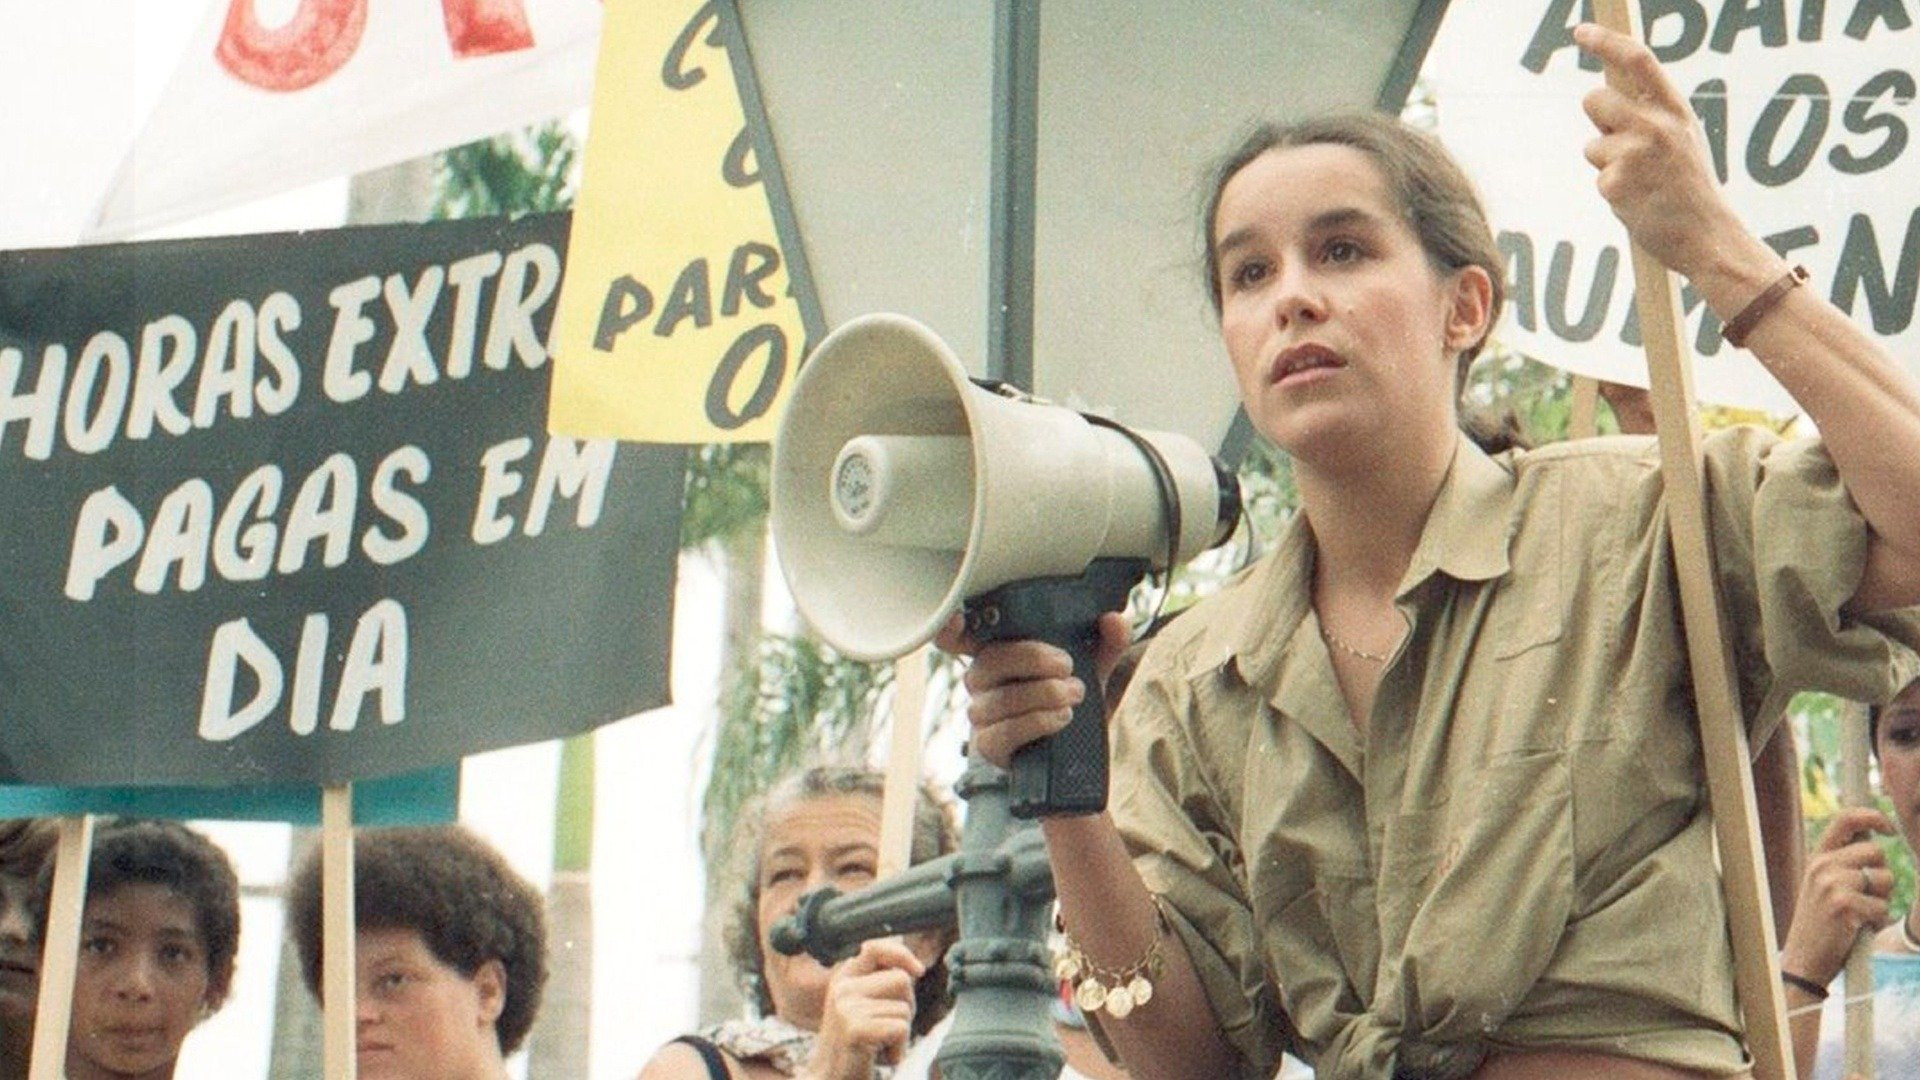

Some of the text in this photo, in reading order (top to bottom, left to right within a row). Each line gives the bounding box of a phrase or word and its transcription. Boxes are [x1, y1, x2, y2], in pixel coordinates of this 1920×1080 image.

[0, 243, 562, 460] HORAS EXTR
[593, 241, 796, 352] PAR
[65, 436, 618, 601] PAGAS EM
[198, 599, 409, 741] DIA
